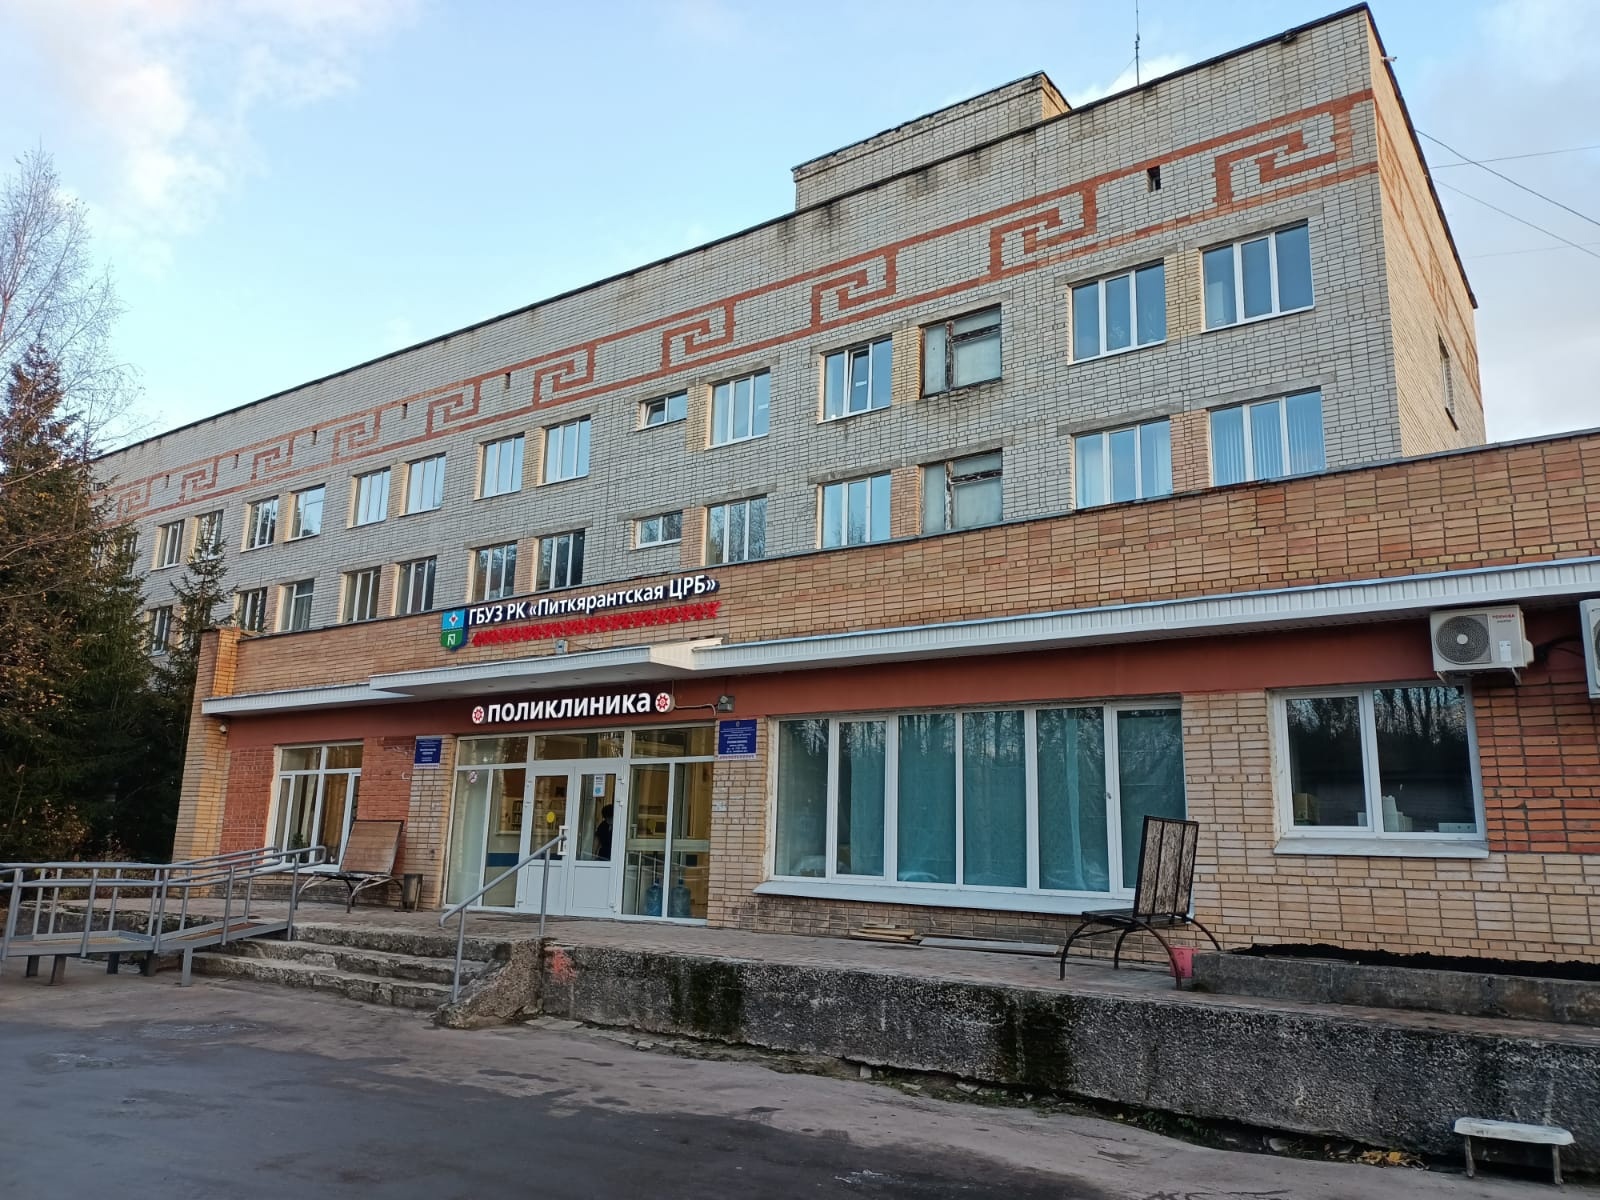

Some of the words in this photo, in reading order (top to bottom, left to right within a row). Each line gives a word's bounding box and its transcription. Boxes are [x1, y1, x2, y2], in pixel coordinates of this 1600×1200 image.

[469, 605, 503, 625] ГБУЗ
[506, 602, 526, 620] РК
[529, 585, 664, 614] «Питкярантская
[669, 575, 717, 600] ЦРБ»
[487, 692, 651, 723] поликлиника
